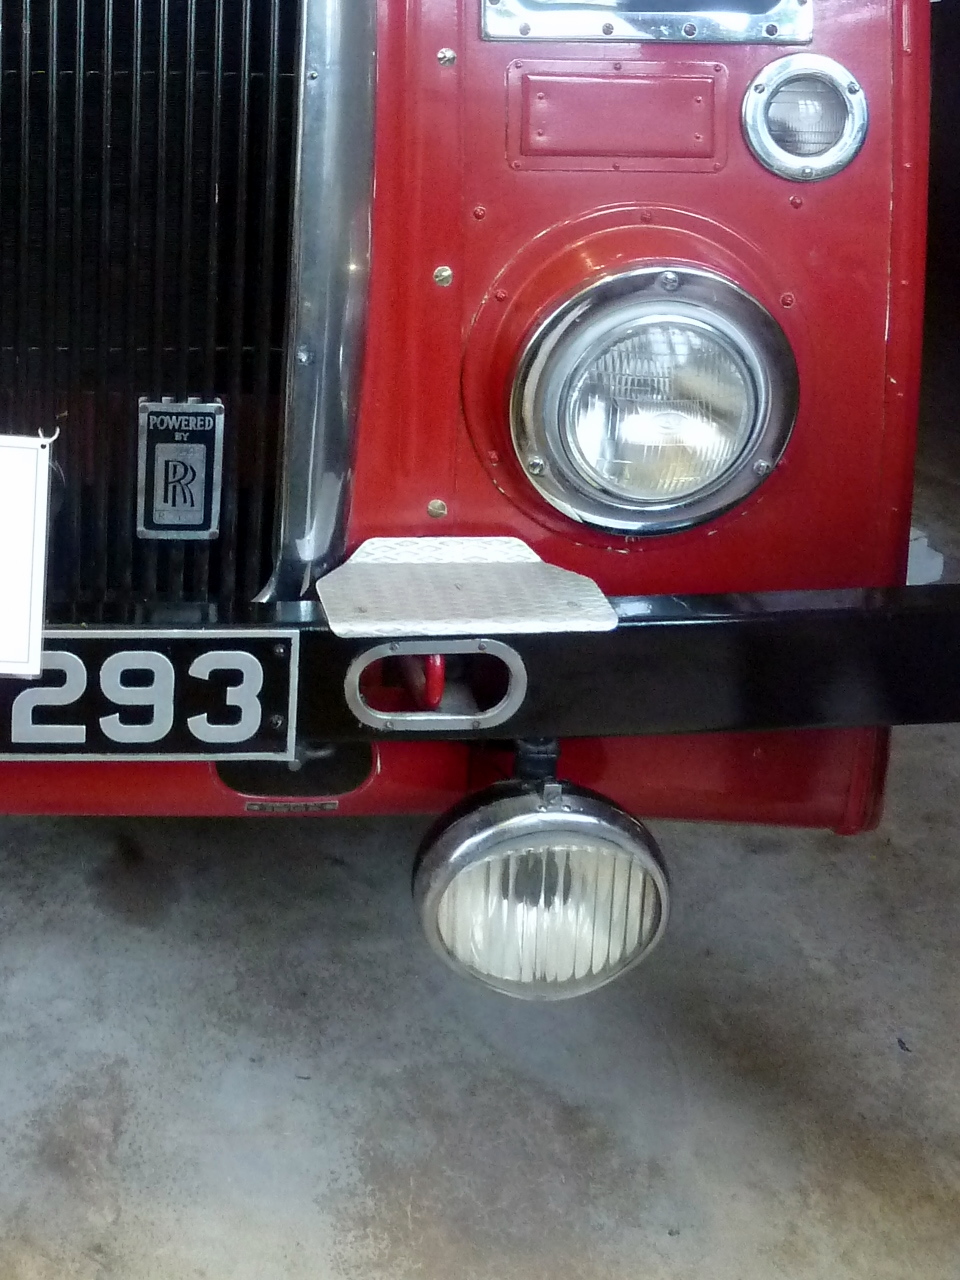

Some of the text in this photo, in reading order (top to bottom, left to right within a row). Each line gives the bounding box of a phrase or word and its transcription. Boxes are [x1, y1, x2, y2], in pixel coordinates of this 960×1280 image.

[149, 415, 214, 431] POWERED
[174, 432, 190, 442] BY
[11, 650, 264, 742] 293
